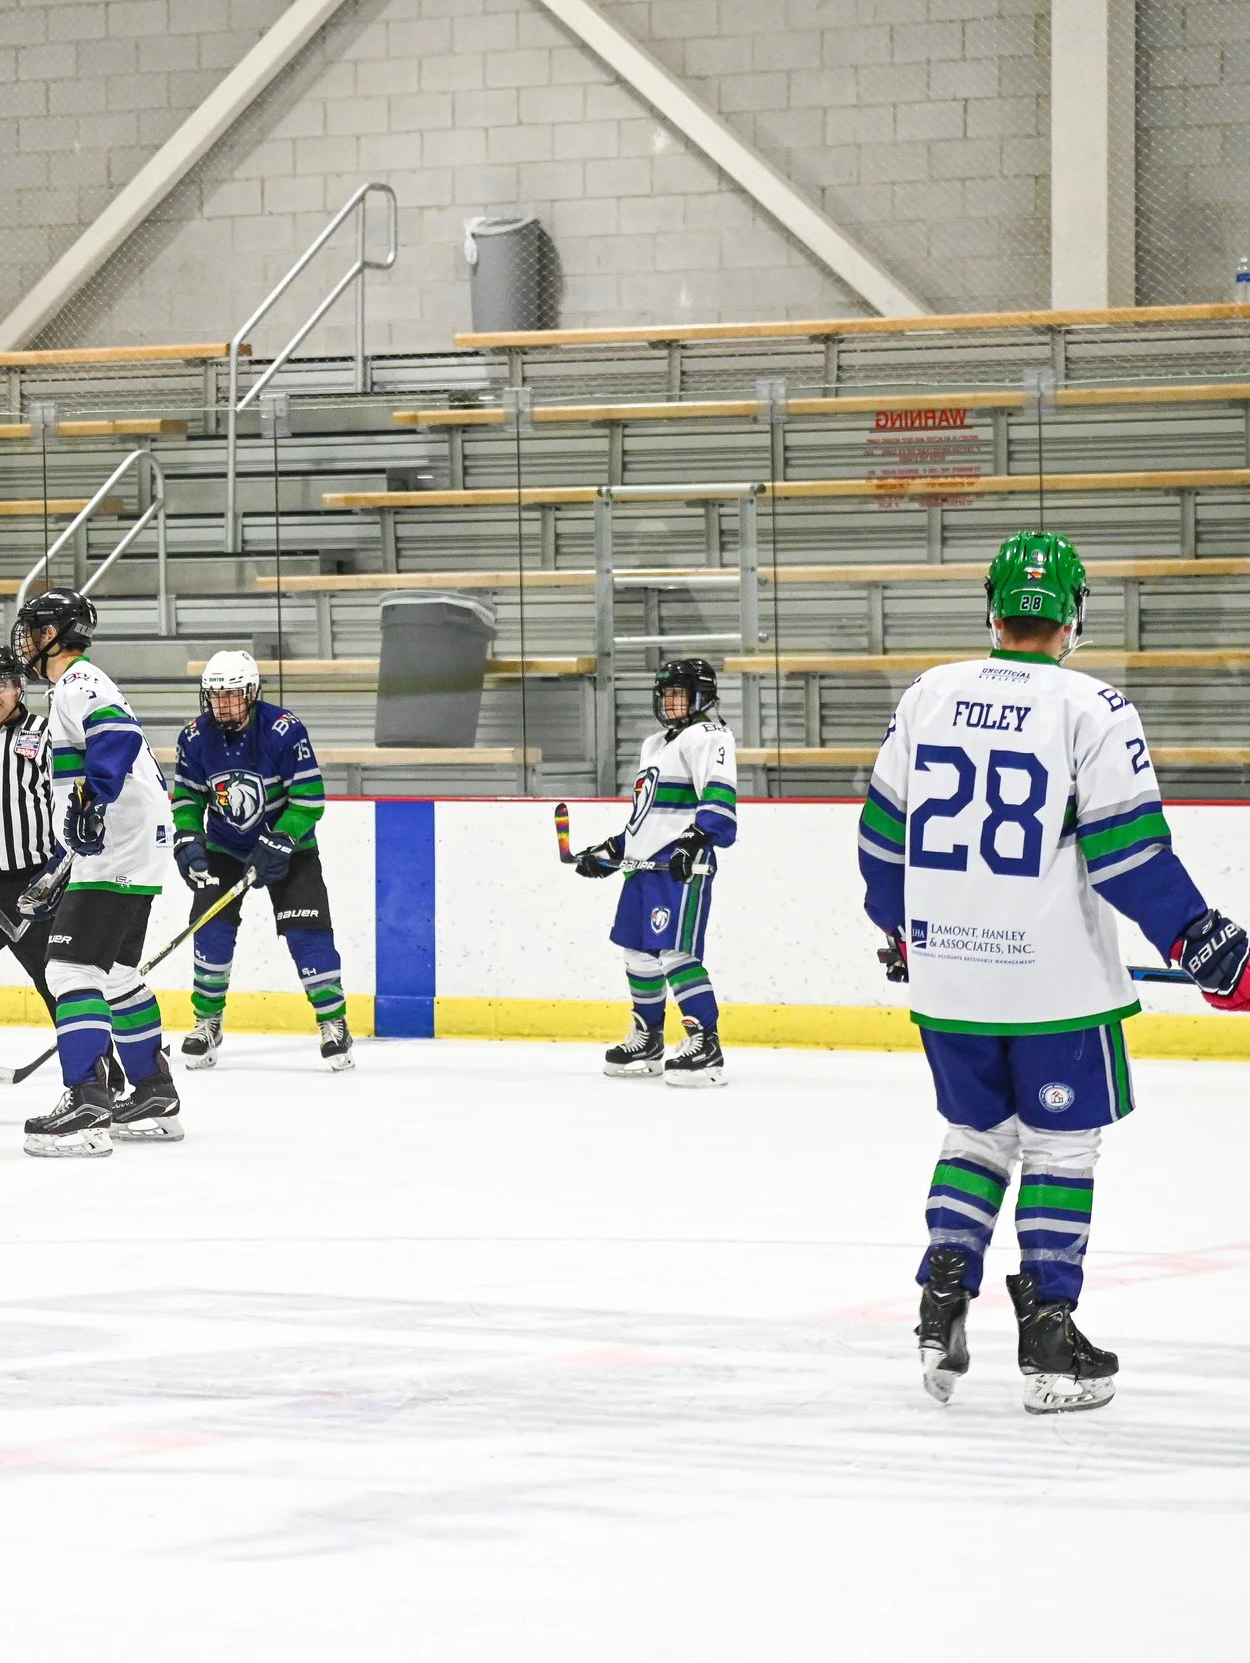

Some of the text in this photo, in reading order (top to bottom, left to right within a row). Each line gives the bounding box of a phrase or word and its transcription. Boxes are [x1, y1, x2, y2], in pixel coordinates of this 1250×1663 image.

[1020, 595, 1043, 612] 28
[952, 701, 1031, 732] FOLEY
[1125, 738, 1150, 775] 2
[909, 743, 1049, 878] 28
[276, 909, 319, 921] BAUER
[930, 923, 1027, 941] LAMONT, HANLEY
[929, 937, 1036, 955] & ASSOCIATES, INC.
